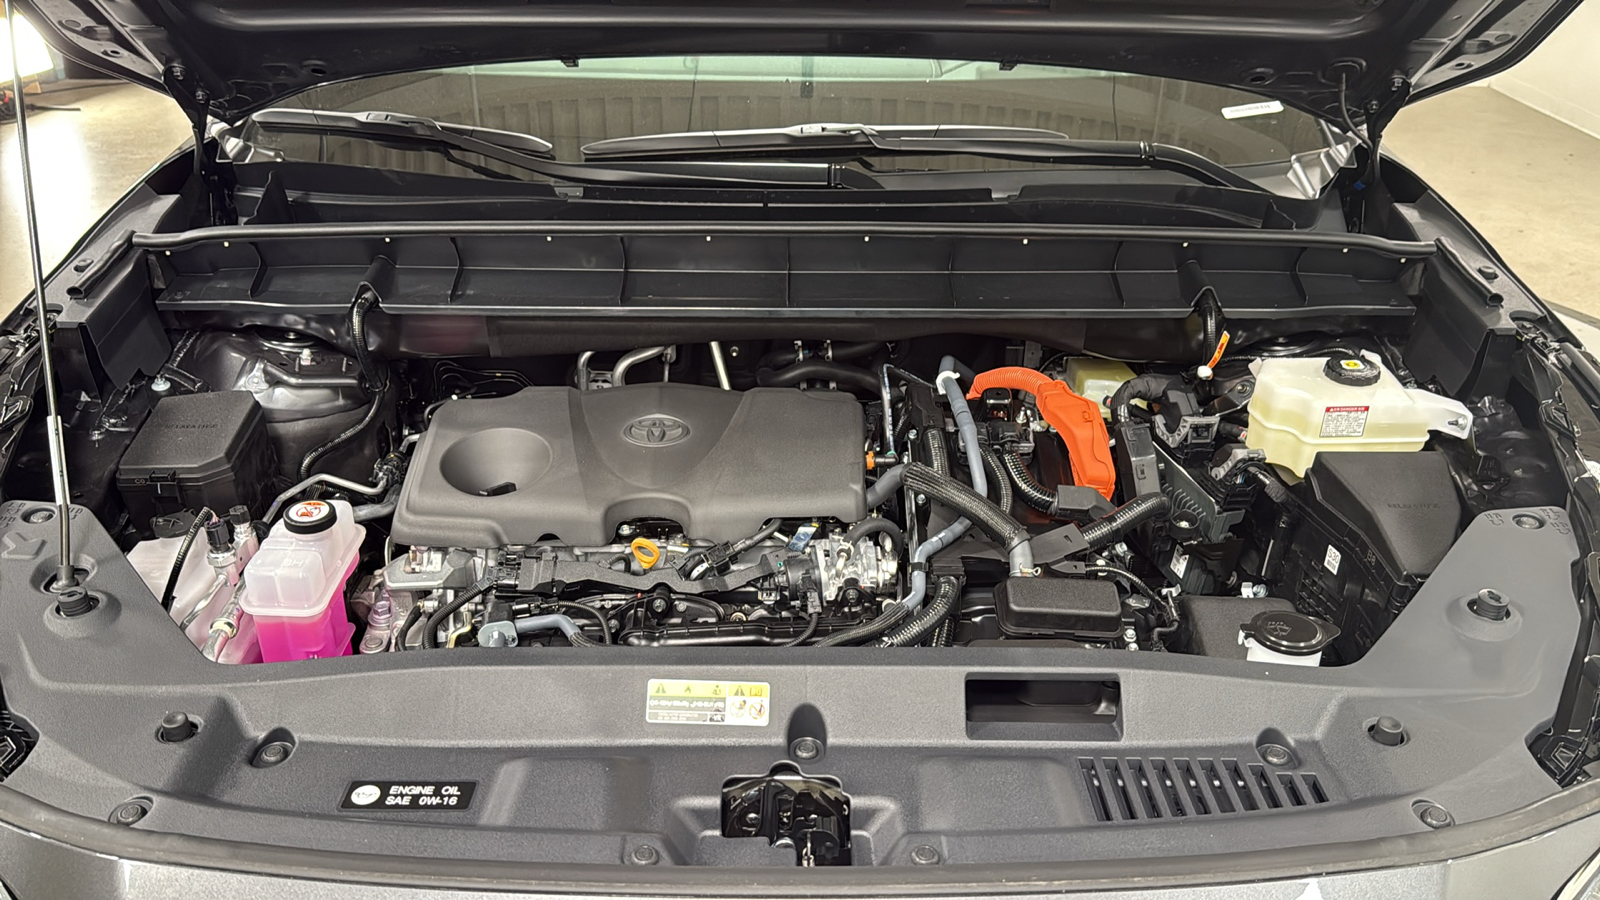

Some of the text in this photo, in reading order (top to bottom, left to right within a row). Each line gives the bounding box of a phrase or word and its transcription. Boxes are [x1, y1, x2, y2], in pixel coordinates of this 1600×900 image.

[389, 785, 461, 795] ENGINE OIL
[385, 796, 458, 805] SAE 0W-16
